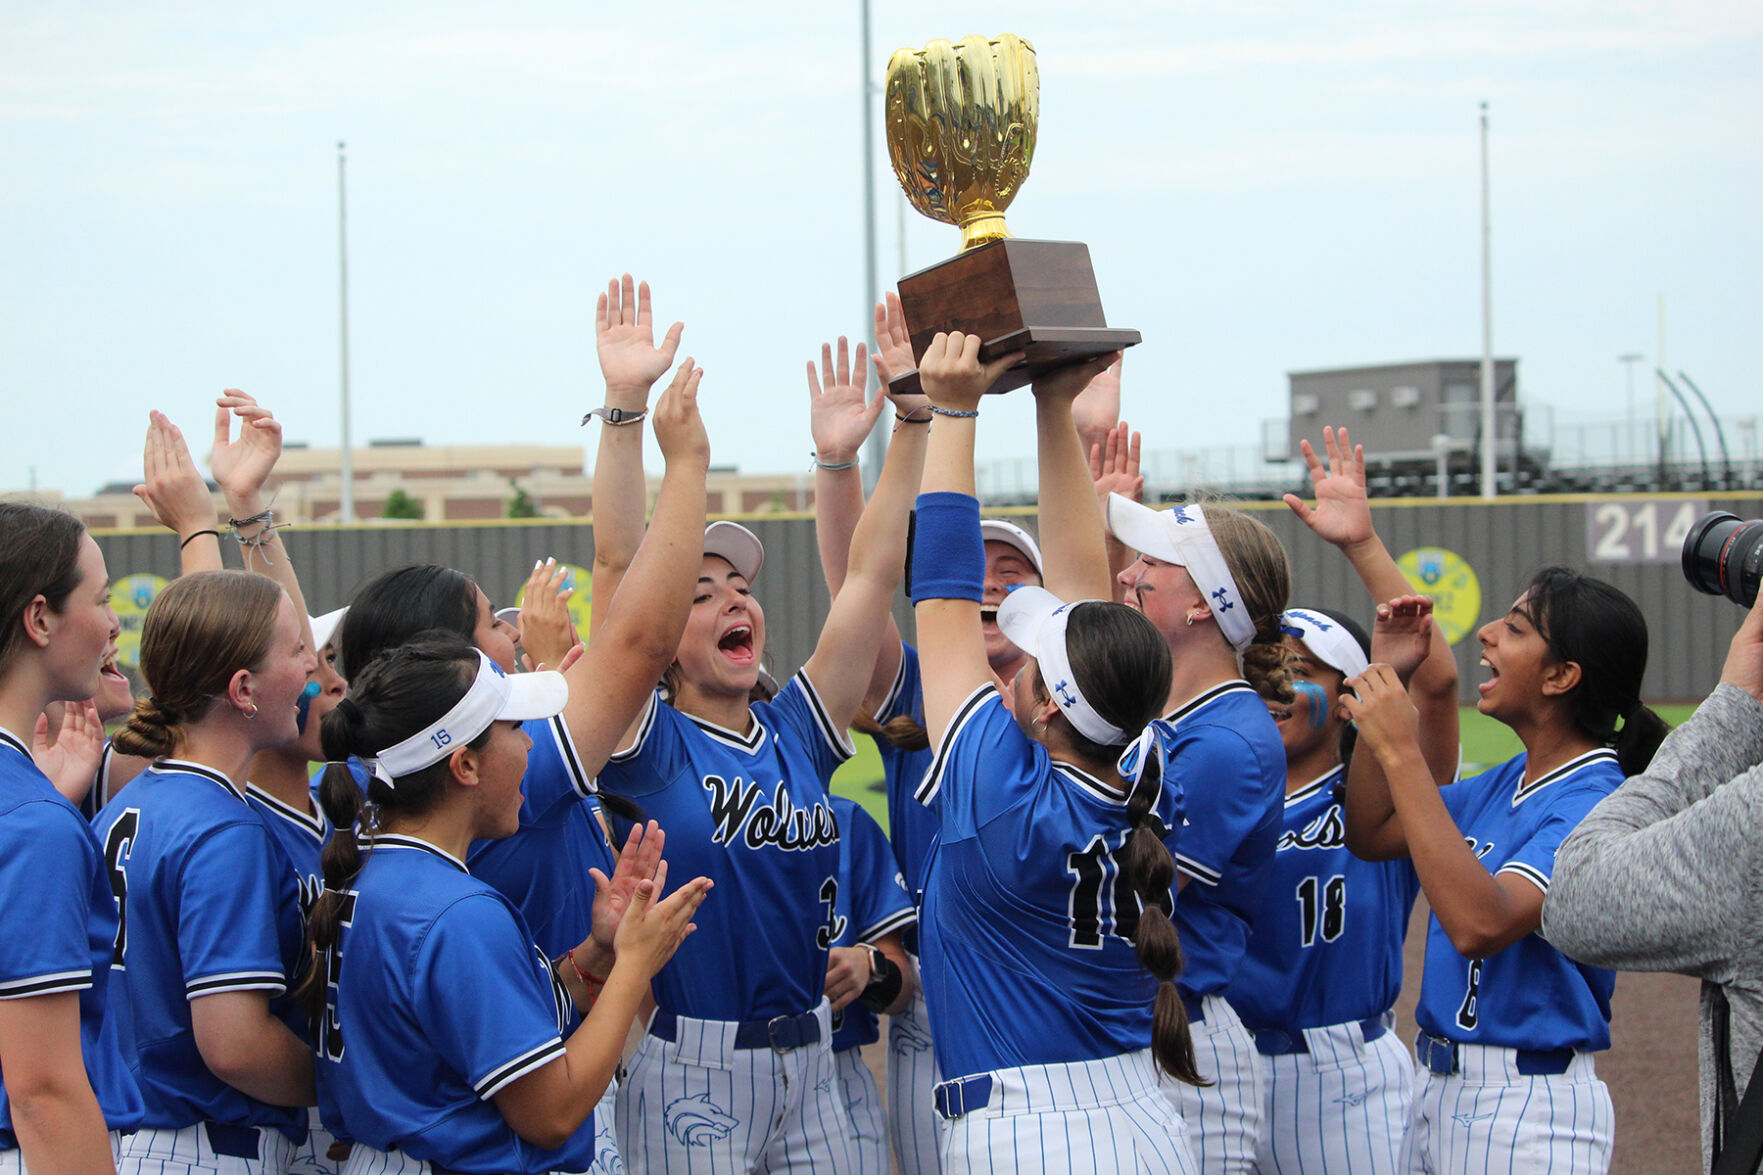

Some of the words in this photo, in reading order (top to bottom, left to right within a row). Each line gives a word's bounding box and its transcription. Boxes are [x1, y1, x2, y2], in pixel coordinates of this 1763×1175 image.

[1595, 502, 1696, 560] 214
[430, 728, 453, 750] 15
[1296, 874, 1346, 948] 18
[1456, 959, 1484, 1031] 8
